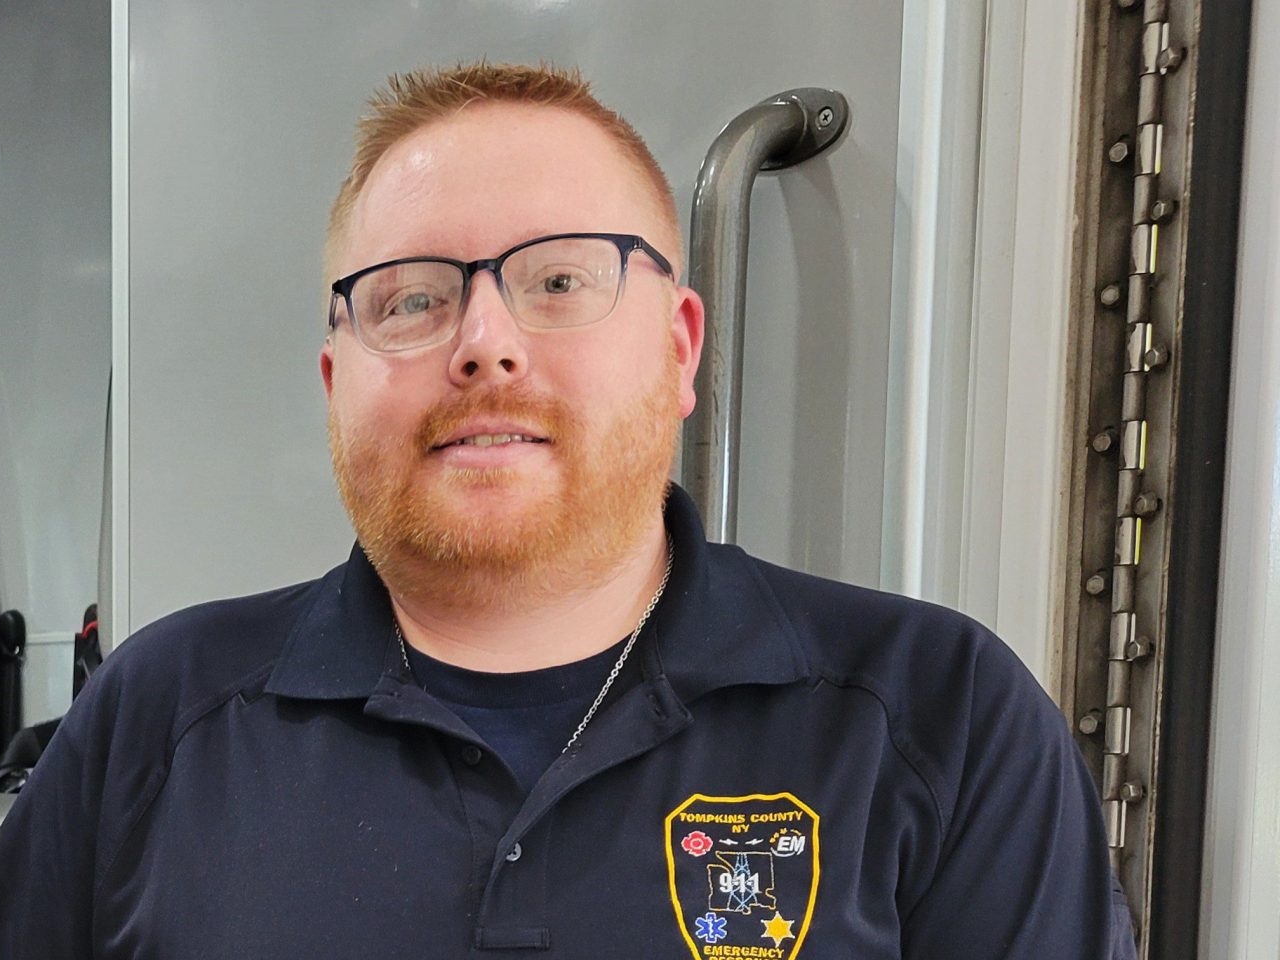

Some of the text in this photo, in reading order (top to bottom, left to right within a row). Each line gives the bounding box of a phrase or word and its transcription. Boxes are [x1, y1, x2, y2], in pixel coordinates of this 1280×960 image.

[679, 811, 804, 824] TOMPKINS COUNTY
[731, 825, 750, 833] NY
[777, 835, 806, 855] EM
[719, 872, 762, 893] 911
[703, 945, 785, 959] EMERGENCY
